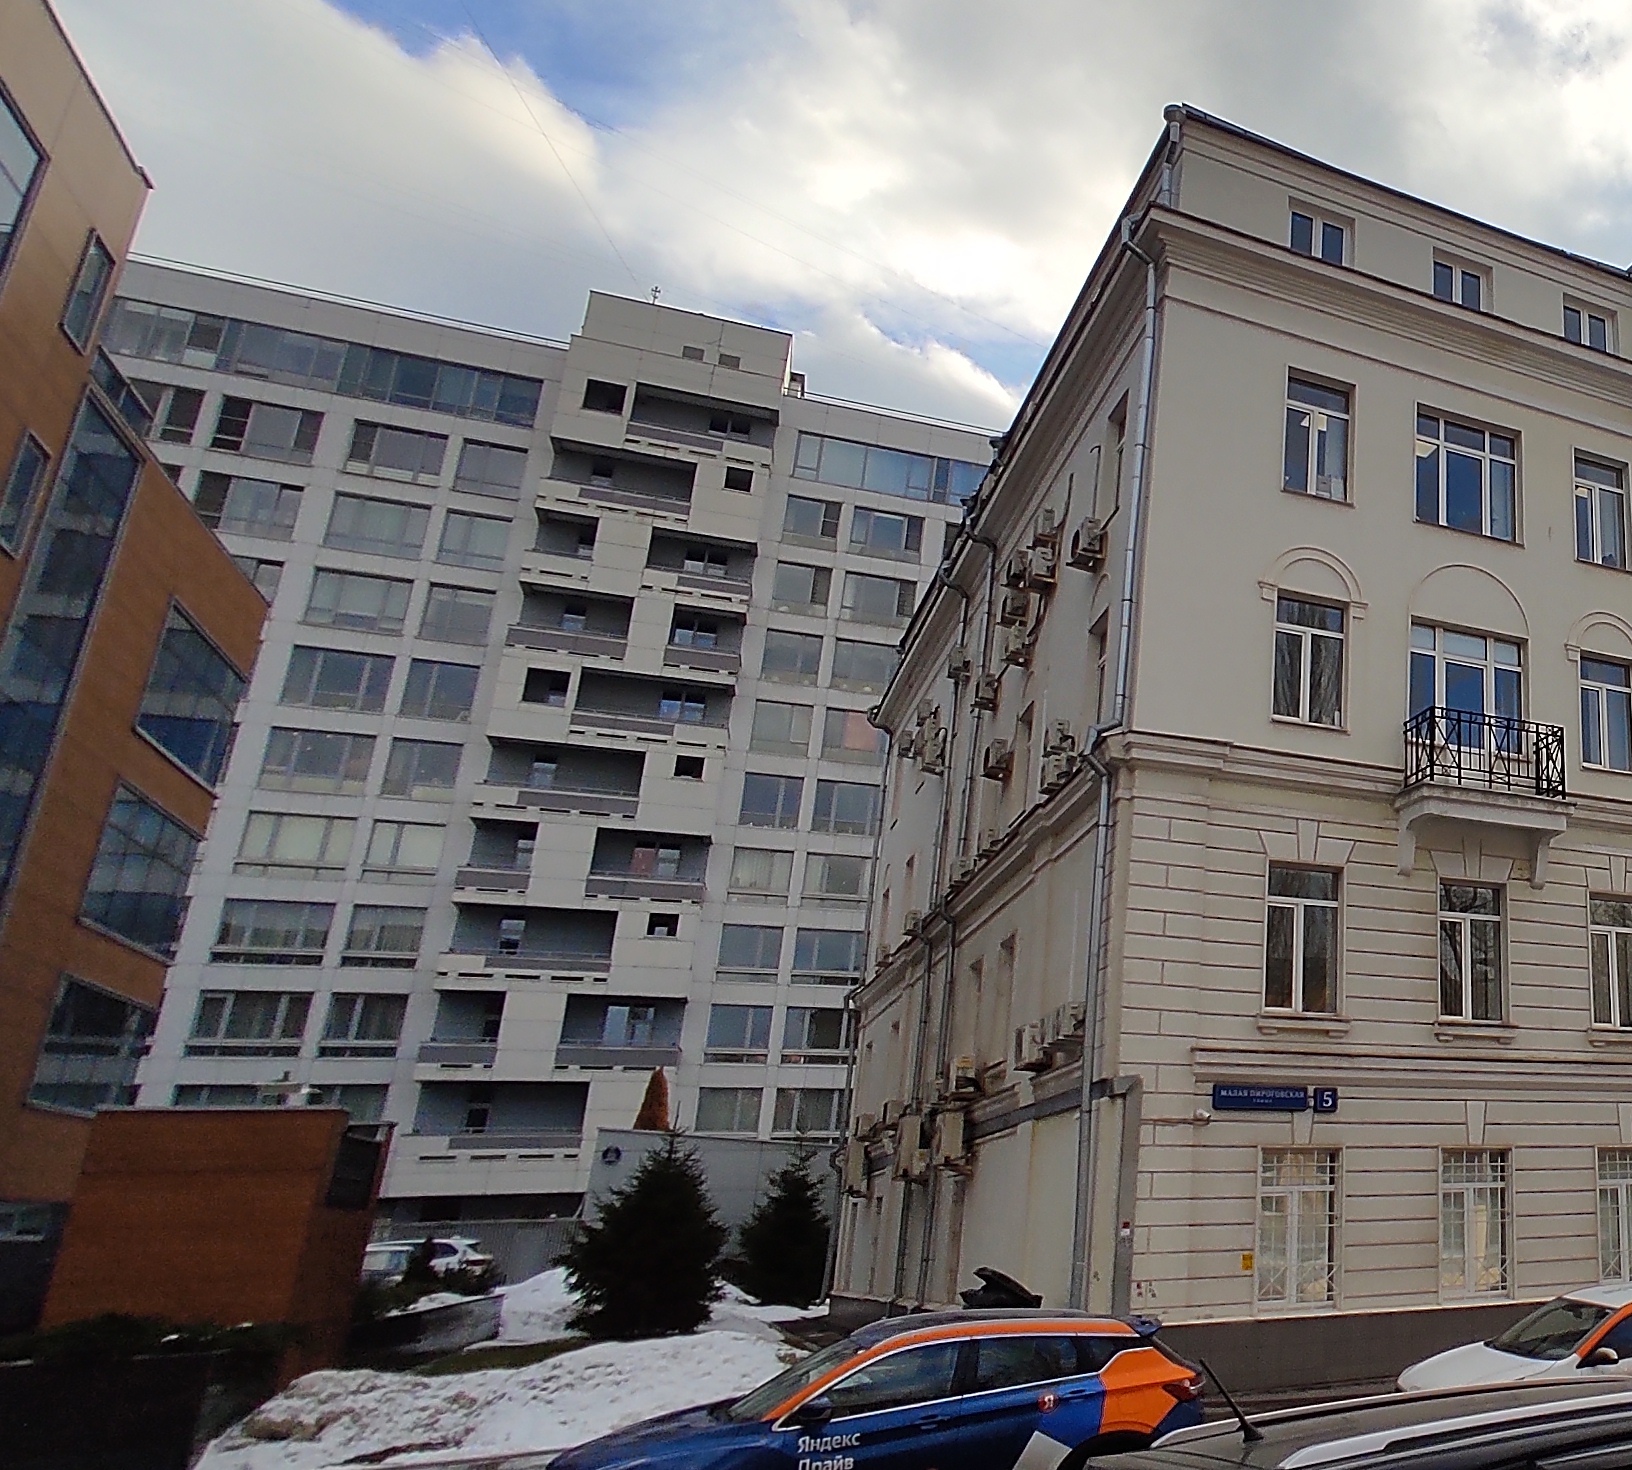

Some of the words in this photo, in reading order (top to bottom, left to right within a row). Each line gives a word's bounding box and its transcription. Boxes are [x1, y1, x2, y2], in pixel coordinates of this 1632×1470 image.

[1220, 1089, 1248, 1097] МАЛАЯ
[1322, 1091, 1333, 1107] 5
[797, 1433, 861, 1453] Яндекс
